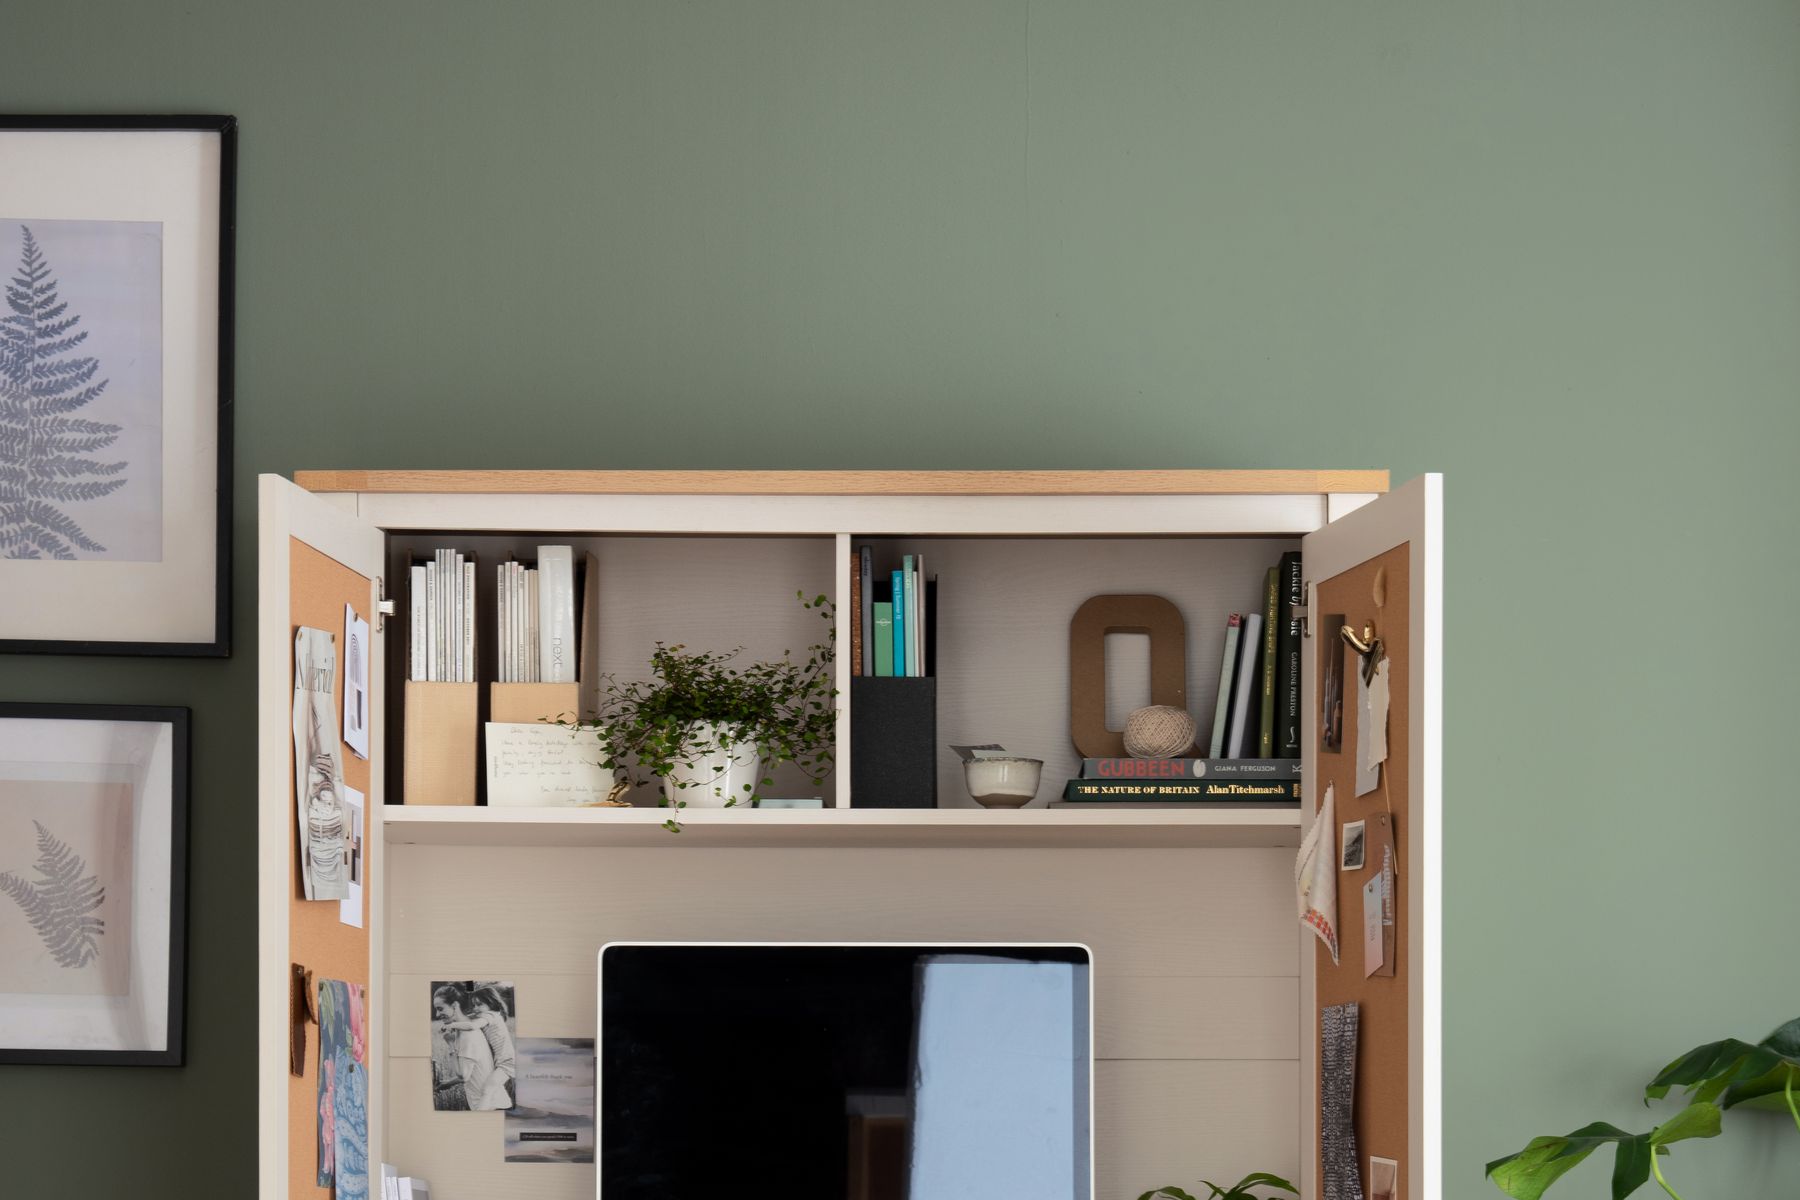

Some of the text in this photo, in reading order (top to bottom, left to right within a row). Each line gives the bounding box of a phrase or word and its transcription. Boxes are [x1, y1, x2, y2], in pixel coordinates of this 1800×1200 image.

[552, 637, 562, 669] next
[1098, 759, 1185, 777] GUBBEEN
[1078, 786, 1200, 795] THE NATURE OF BRITAIN
